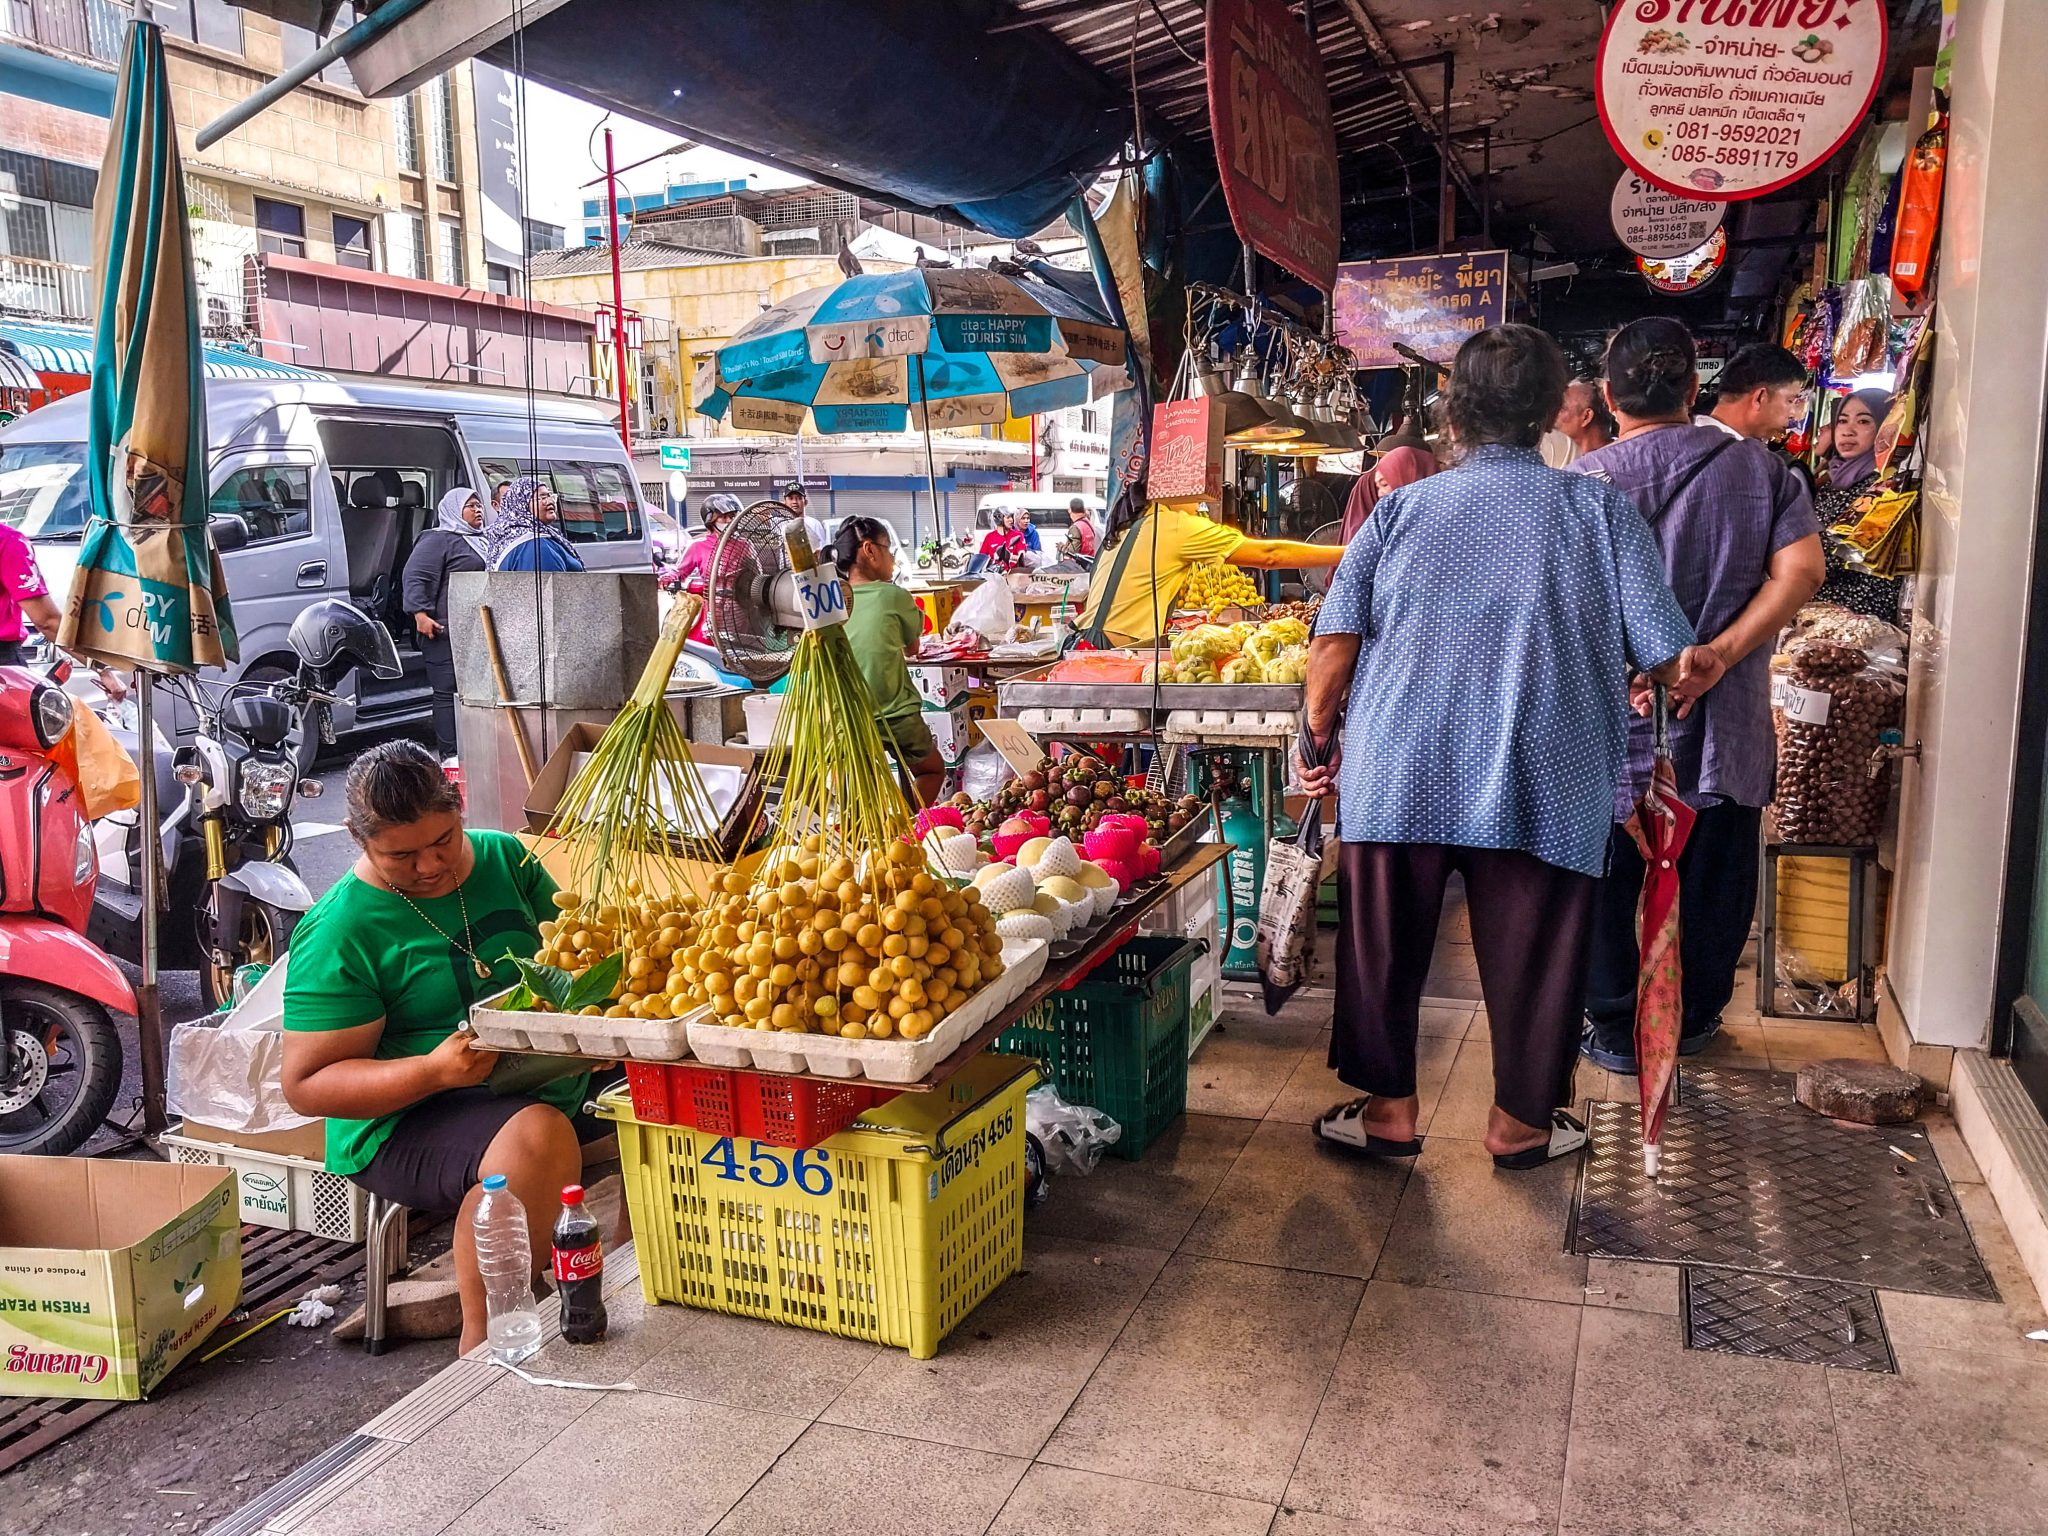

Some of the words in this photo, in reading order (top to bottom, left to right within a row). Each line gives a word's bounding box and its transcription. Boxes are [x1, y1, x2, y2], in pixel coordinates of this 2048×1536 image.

[1676, 122, 1801, 146] 081-9592021
[1671, 145, 1798, 169] 085-5891179
[1627, 223, 1688, 235] 084-1931687
[1479, 290, 1492, 306] A
[961, 319, 986, 331] dtac
[988, 320, 1026, 332] HAPPY
[888, 328, 915, 342] dtac
[961, 332, 1007, 344] TOURIST
[1009, 334, 1027, 345] SIM
[800, 579, 844, 619] 300
[1002, 734, 1029, 756] 40
[988, 1105, 1014, 1144] 456
[701, 1135, 835, 1197] 456
[243, 1194, 288, 1214] สายัณห์
[4, 1265, 31, 1274] china
[34, 1266, 44, 1275] of
[46, 1267, 87, 1277] Produce
[43, 1299, 91, 1314] FRESH
[194, 1304, 218, 1333] FRESH
[6, 1343, 109, 1385] Guang
